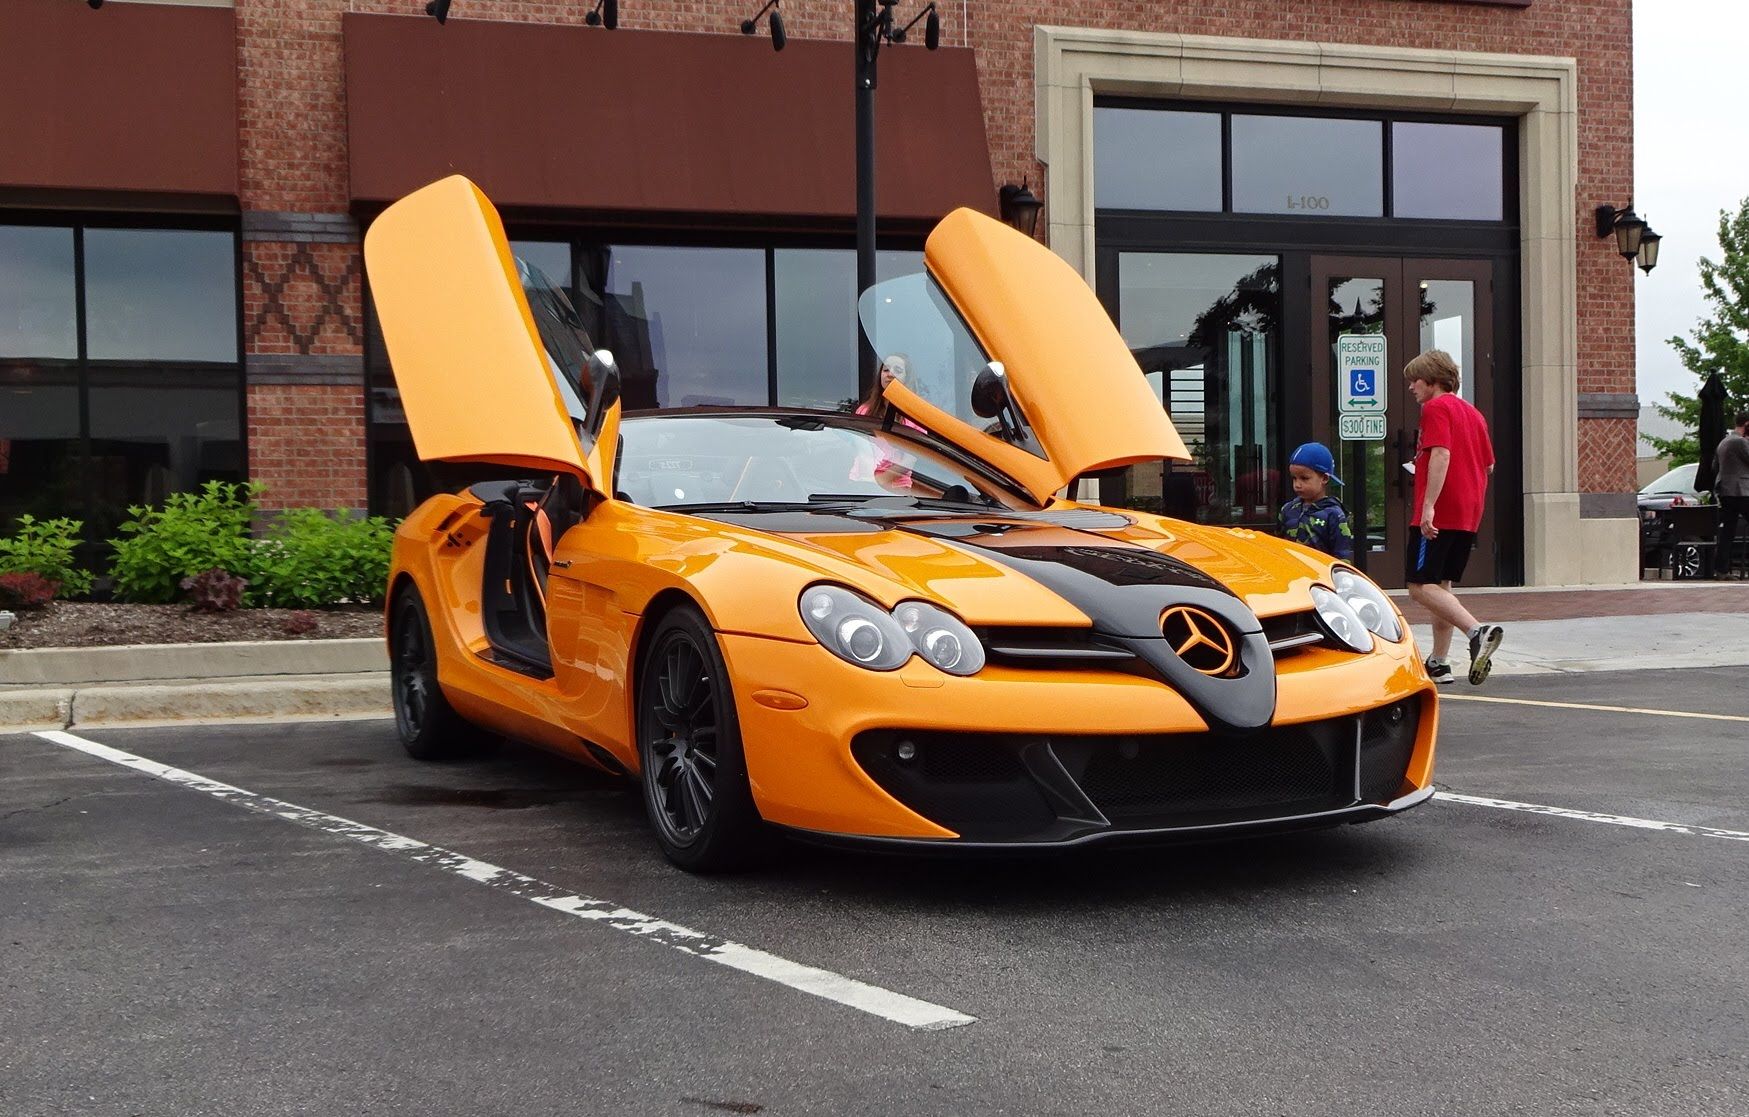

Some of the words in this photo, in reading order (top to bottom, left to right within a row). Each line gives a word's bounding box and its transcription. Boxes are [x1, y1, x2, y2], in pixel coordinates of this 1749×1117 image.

[1341, 342, 1383, 353] RESERVED
[1345, 356, 1380, 366] PARKING
[1343, 419, 1364, 434] $300
[1365, 419, 1384, 434] FINE
